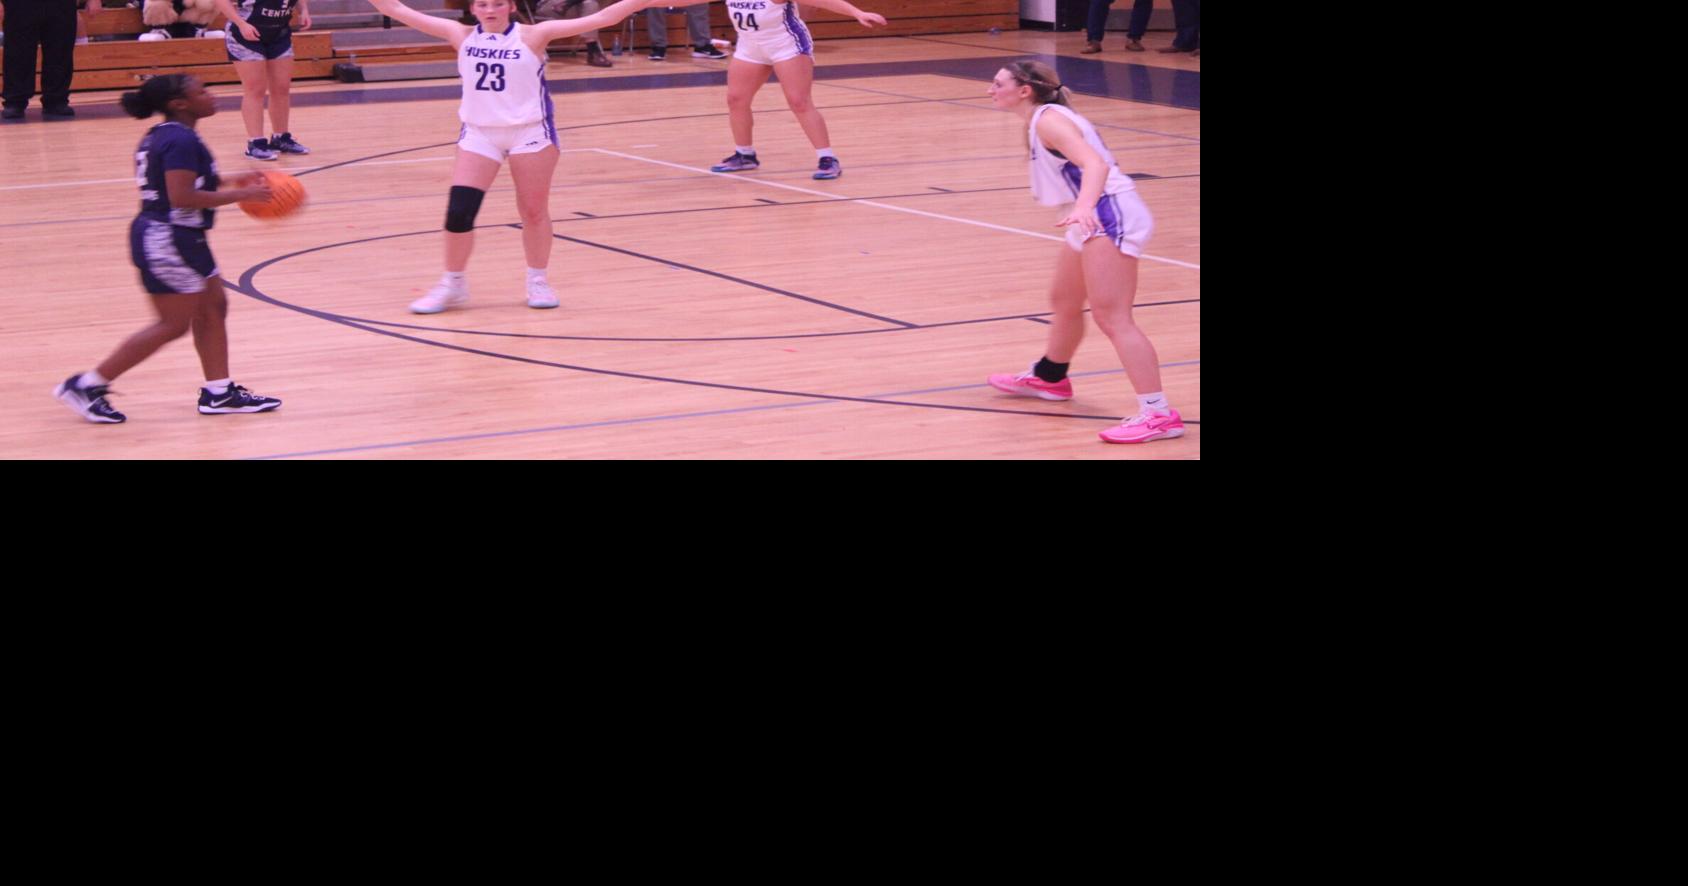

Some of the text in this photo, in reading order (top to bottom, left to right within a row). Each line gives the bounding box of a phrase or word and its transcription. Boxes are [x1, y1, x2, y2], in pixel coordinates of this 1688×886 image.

[729, 1, 766, 10] HUSKES
[733, 11, 760, 31] 24
[465, 46, 521, 60] HUSKIES
[475, 62, 506, 92] 23
